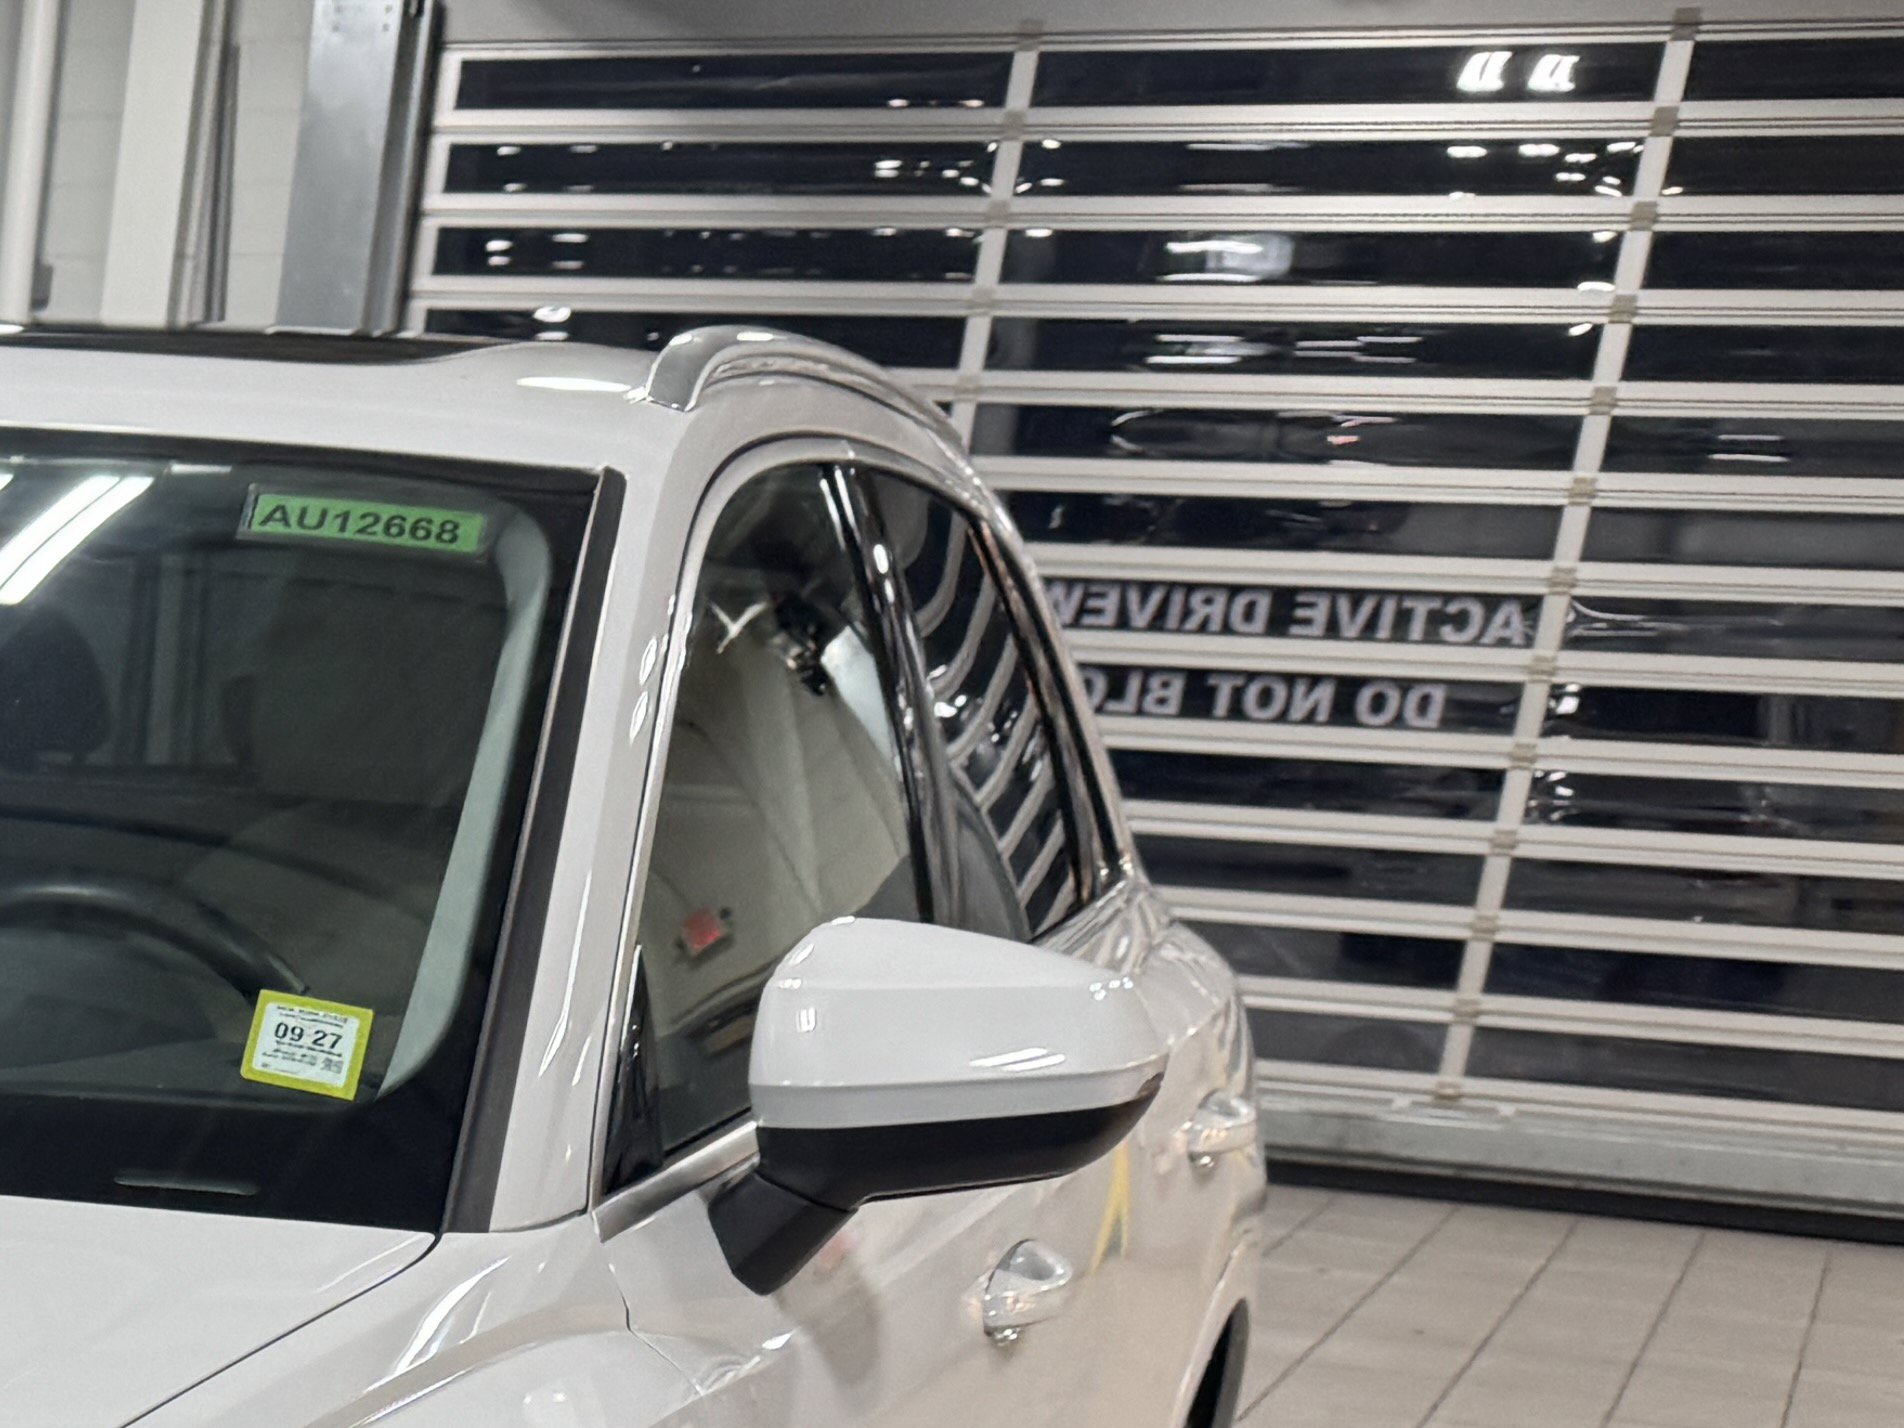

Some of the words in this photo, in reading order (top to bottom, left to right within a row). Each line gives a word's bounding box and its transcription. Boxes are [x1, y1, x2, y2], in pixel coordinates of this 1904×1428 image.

[259, 504, 461, 545] AU12668
[274, 1021, 304, 1042] 09
[312, 1029, 343, 1049] 27
